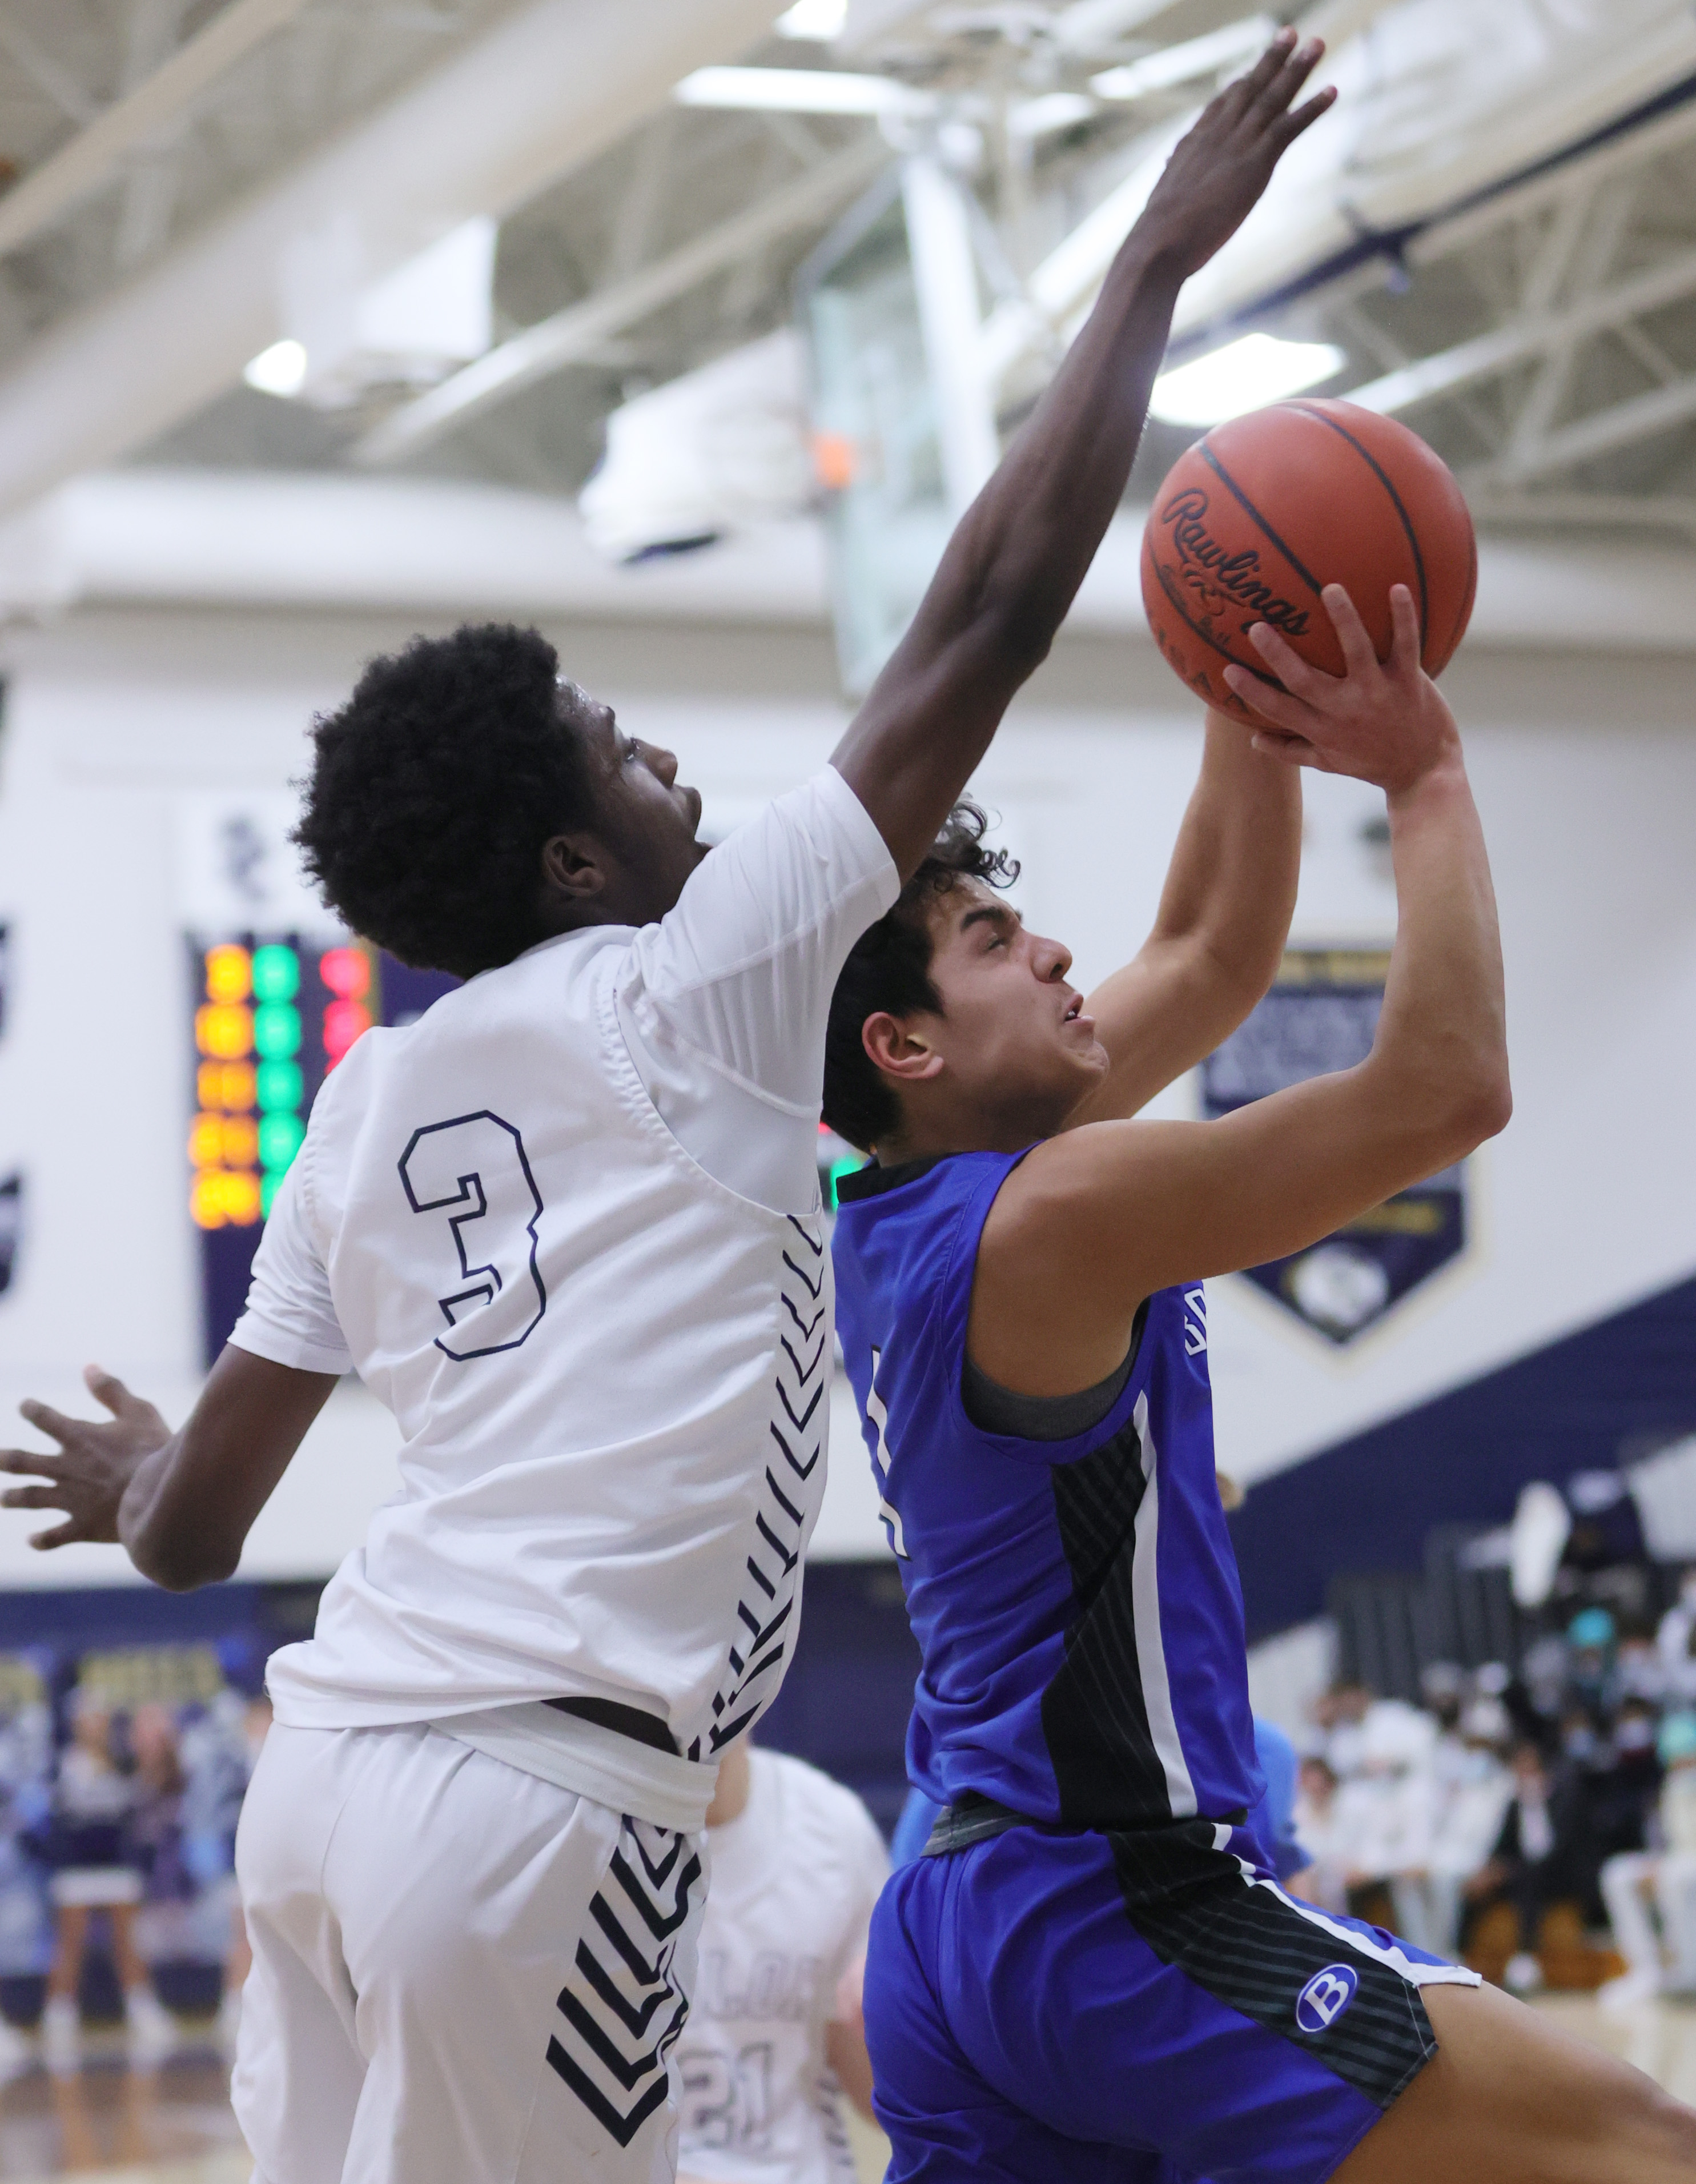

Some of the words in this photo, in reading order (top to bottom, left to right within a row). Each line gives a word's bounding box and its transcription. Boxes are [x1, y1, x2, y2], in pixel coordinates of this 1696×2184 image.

[1163, 488, 1310, 636] Rawlings
[397, 1109, 546, 1362] 3
[1304, 1973, 1349, 2026] B
